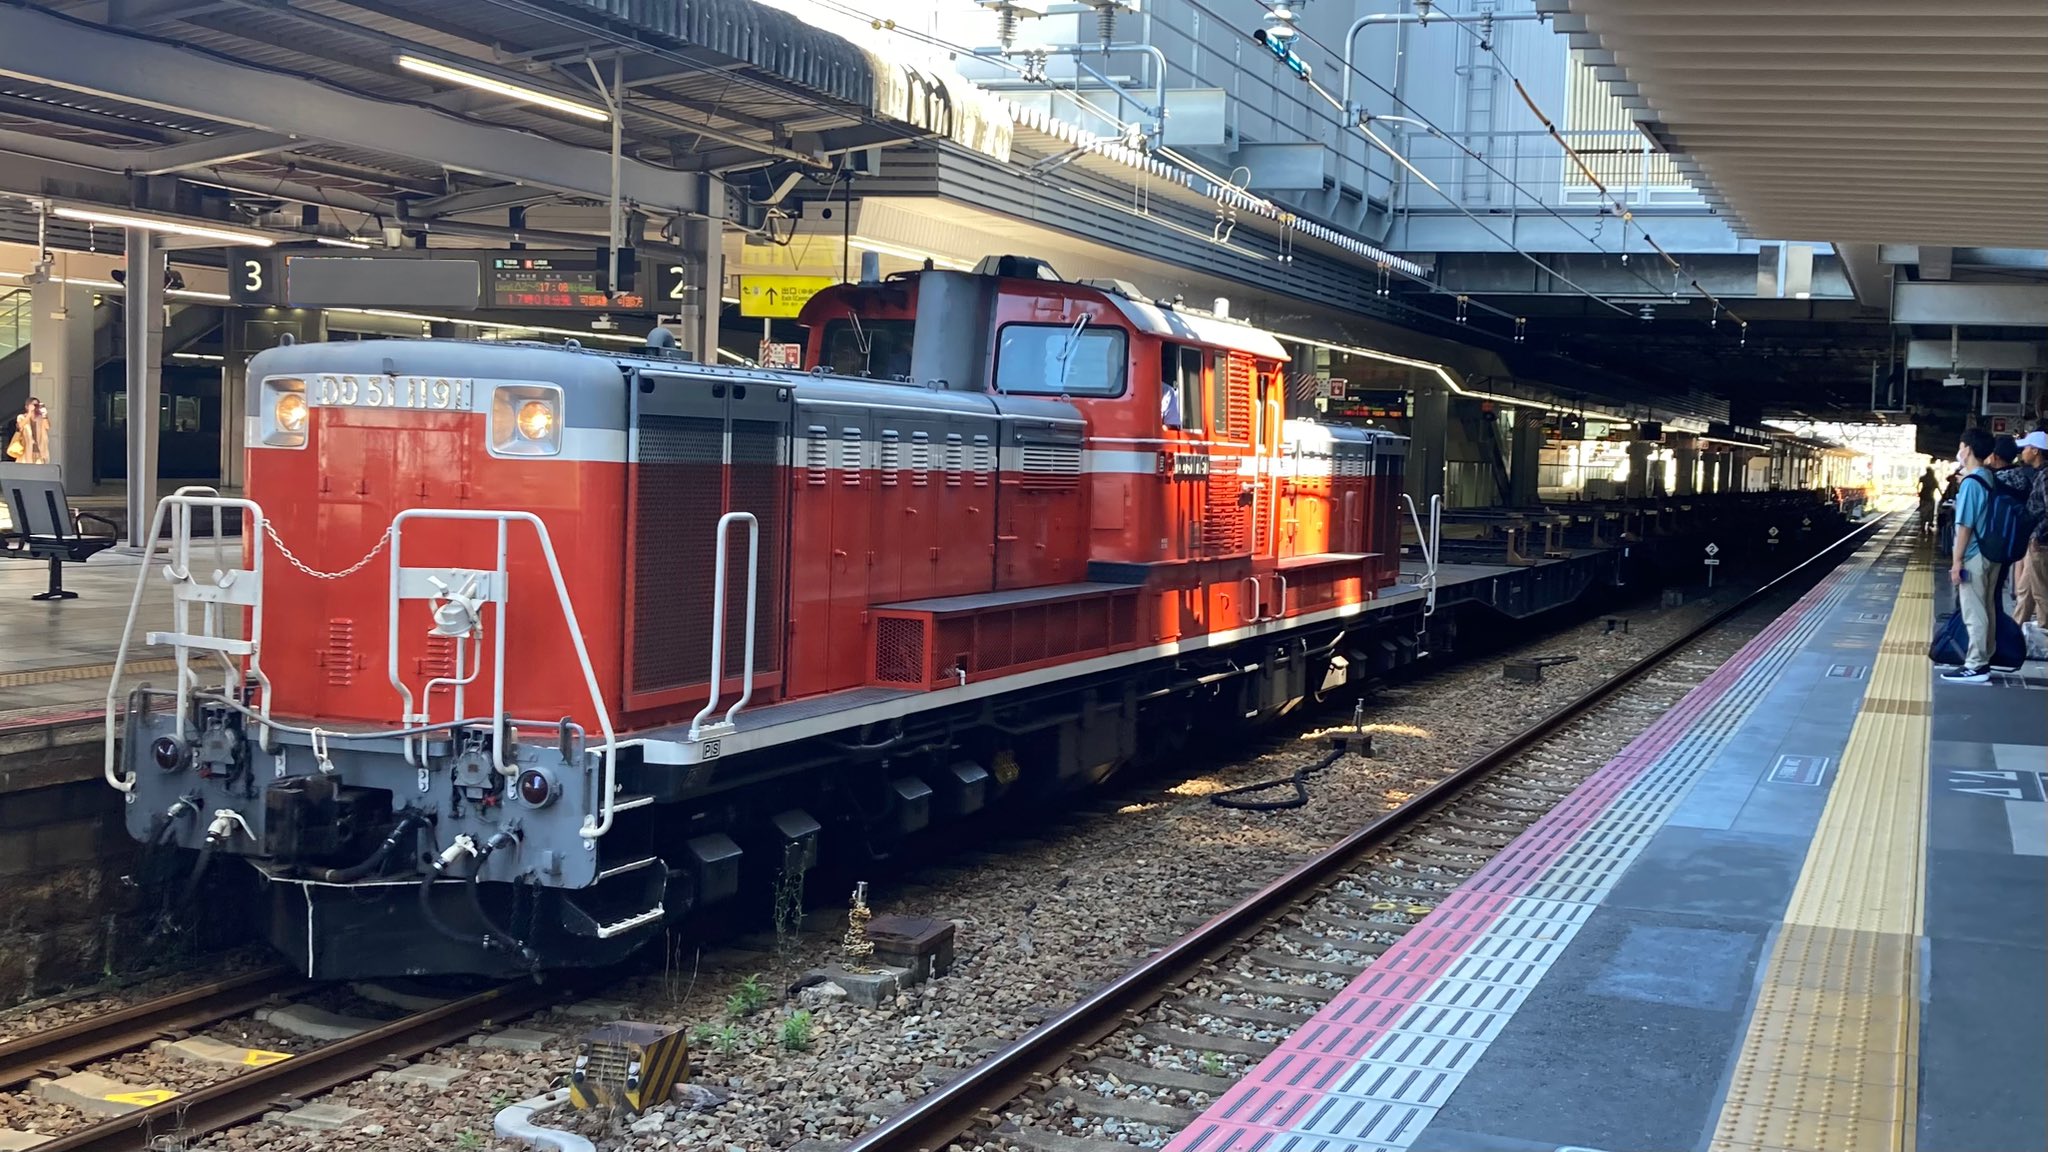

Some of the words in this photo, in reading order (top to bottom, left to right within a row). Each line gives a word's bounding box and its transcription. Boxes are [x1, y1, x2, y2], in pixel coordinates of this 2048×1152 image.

[245, 260, 262, 291] 3
[670, 266, 684, 299] 2
[407, 378, 463, 410] 1191
[1600, 425, 1606, 434] 2
[1709, 545, 1715, 553] 2
